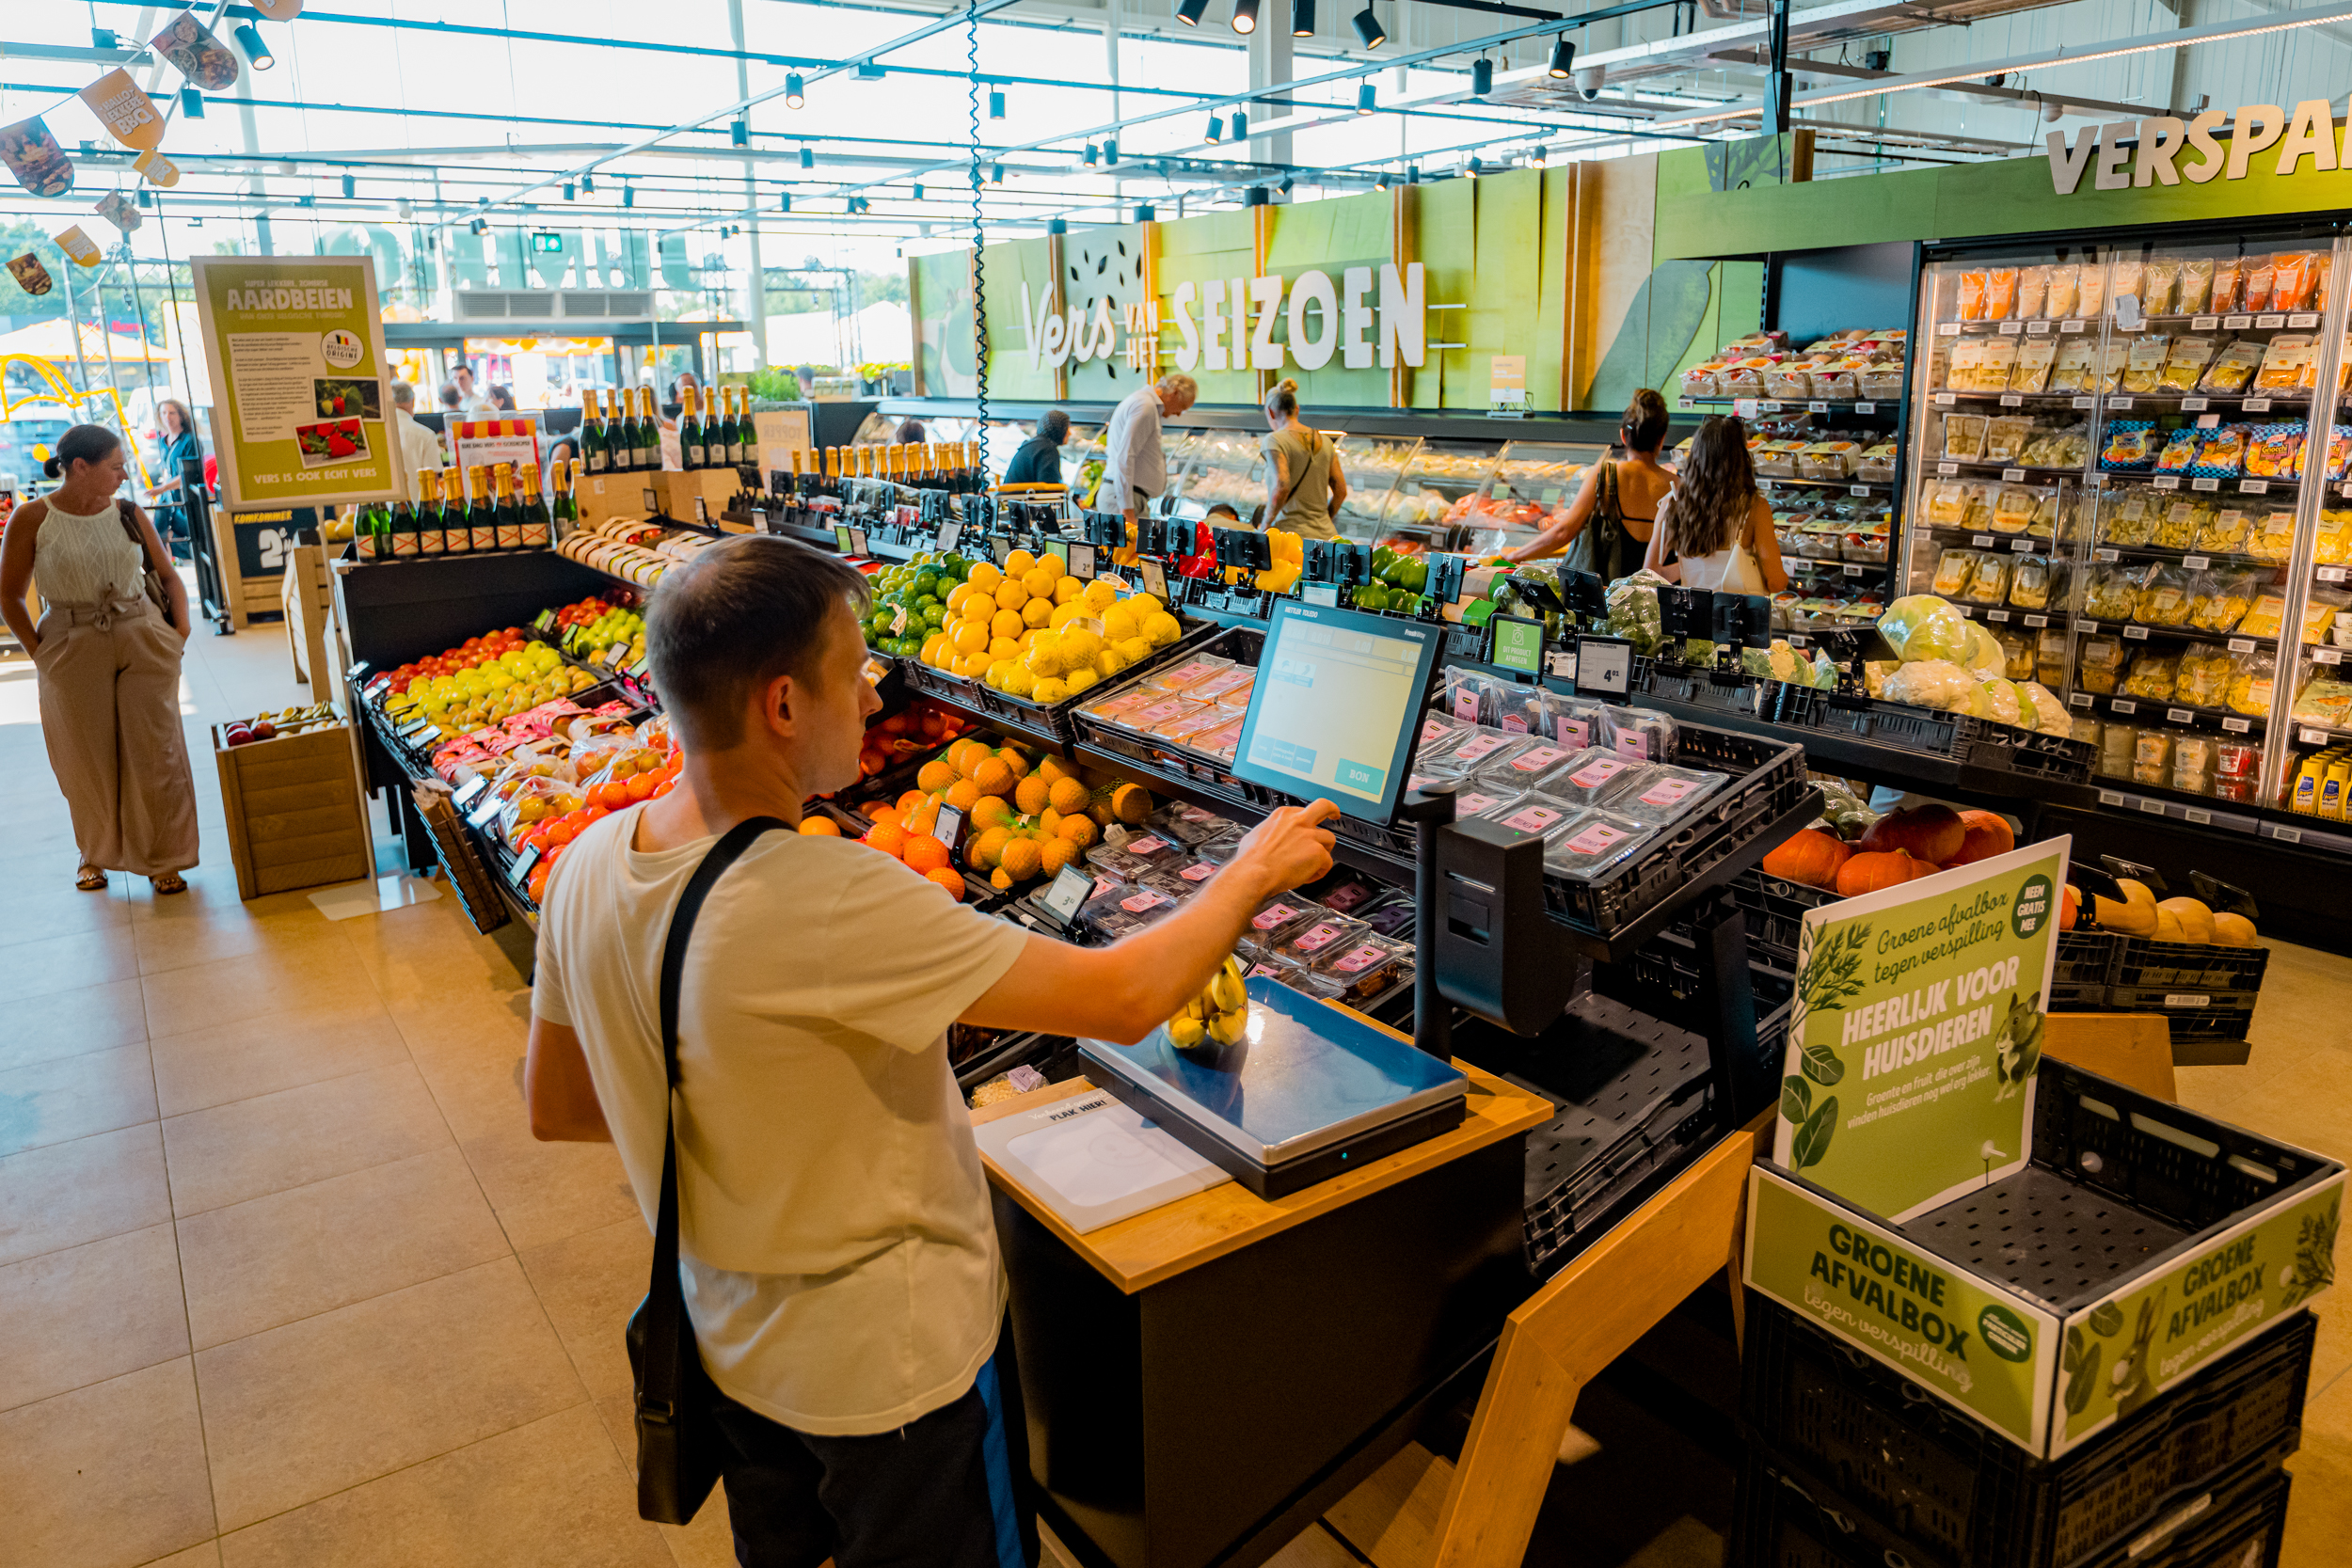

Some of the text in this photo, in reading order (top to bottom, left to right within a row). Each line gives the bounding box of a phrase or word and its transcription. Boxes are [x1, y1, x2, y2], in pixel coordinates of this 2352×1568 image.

[116, 108, 154, 135] BBQ
[2046, 94, 2352, 195] VERSPA
[228, 289, 353, 310] AARDBEIEN
[1021, 280, 1116, 371] Vers
[1123, 300, 1158, 333] VAN
[1173, 262, 1426, 372] SEIZOEN
[326, 350, 357, 358] ORIGINE
[1125, 337, 1159, 368] HET
[254, 467, 376, 483] VERS IS OOK ECHT VERS
[234, 510, 293, 524] KOMKOMMER
[1284, 606, 1319, 618] METTLER TOLEDO
[1505, 655, 1527, 665] AFWEGEN
[1510, 646, 1532, 657] PRODUCT
[1349, 769, 1370, 783] BON
[2017, 900, 2045, 916] GRATIS
[2025, 885, 2045, 899] NEEM
[1878, 891, 2009, 955] Groene afvalbox
[2020, 918, 2036, 931] MEE
[1874, 920, 2005, 985] tegen verspilling
[1841, 956, 2020, 1046] HEERLIJK VOOR
[1863, 1004, 1993, 1080] HUISDIEREN
[1867, 1054, 1980, 1106] Groente en fruit die over zijn
[1028, 1101, 1072, 1120] Verkeerd
[1049, 1100, 1107, 1121] PLAK HIER!
[1847, 1066, 1992, 1129] vinden huisdieren nog wel erg lekker.
[1829, 1224, 1946, 1307] GROENE
[2184, 1234, 2256, 1297] GROENE
[1810, 1250, 1970, 1362] AFVALBOX
[2167, 1262, 2266, 1343] AFVALBOX
[1804, 1285, 1856, 1326] tegen
[1858, 1320, 1974, 1393] verspilling
